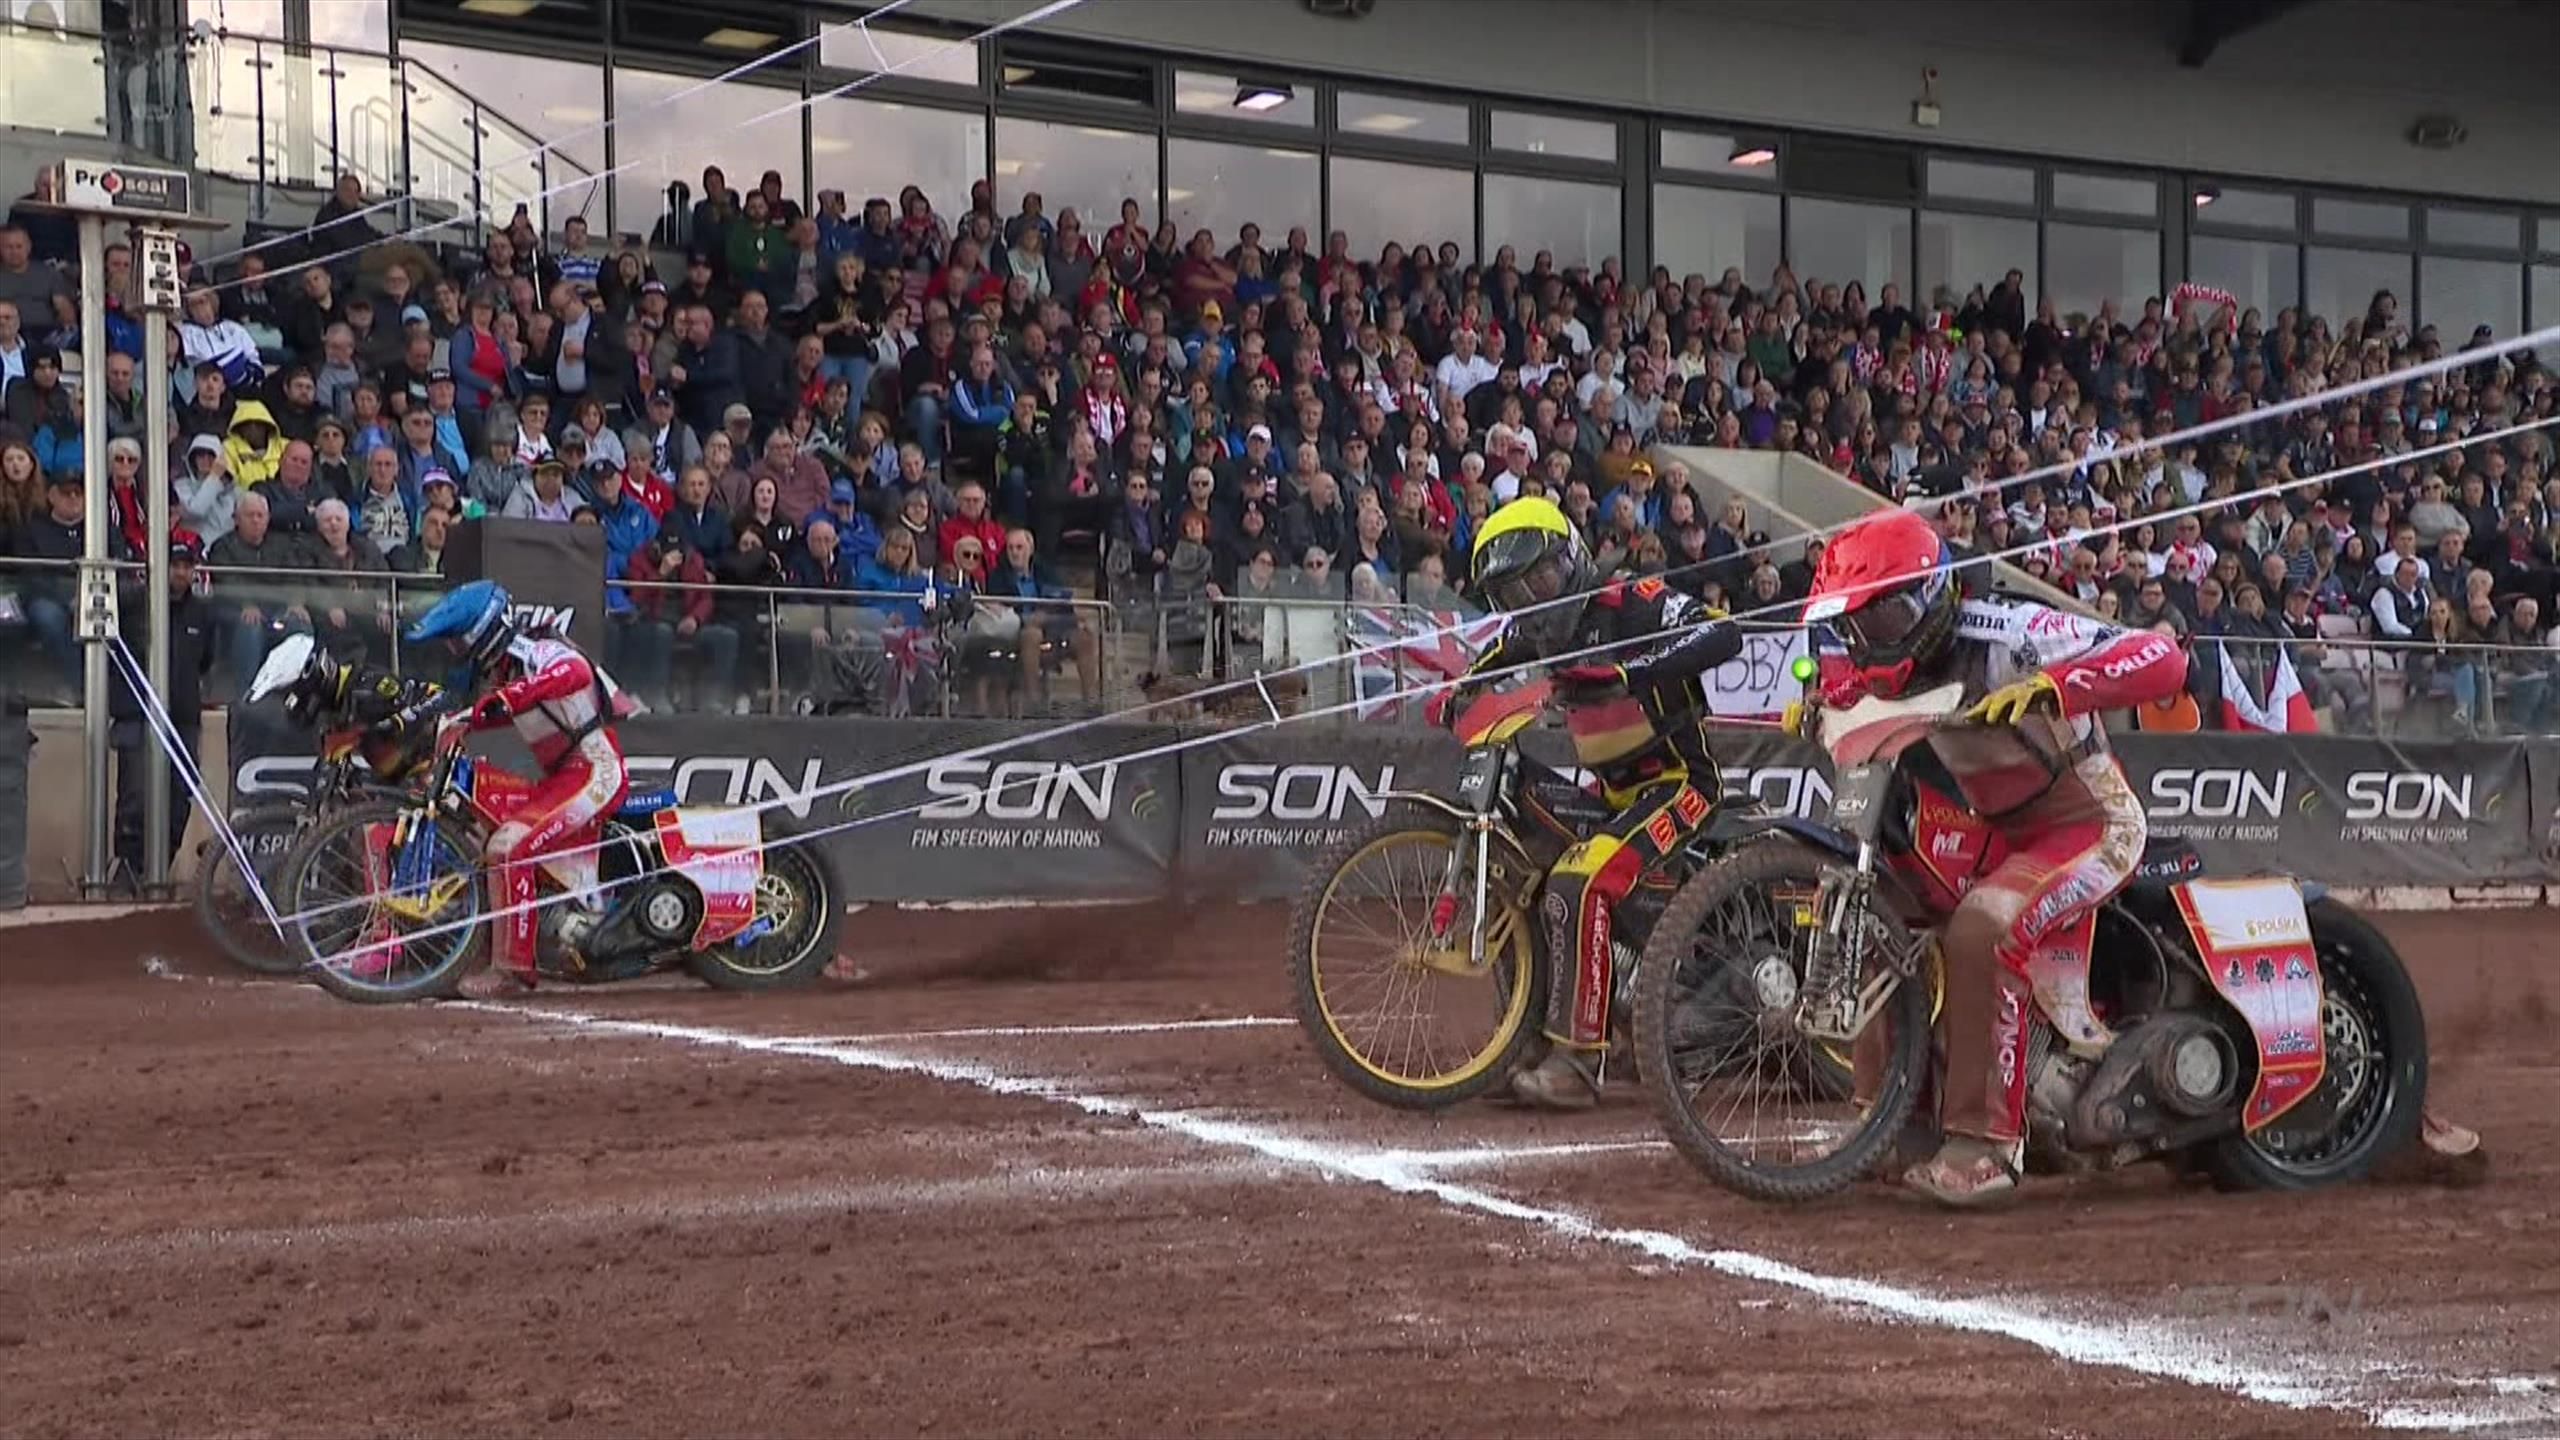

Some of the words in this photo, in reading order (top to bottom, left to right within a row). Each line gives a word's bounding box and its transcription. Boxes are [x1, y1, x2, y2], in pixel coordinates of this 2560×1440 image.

[2104, 639, 2171, 678] ORLEN
[918, 761, 1118, 820] SON
[1212, 763, 1396, 821] SON
[2147, 769, 2287, 818] SON
[2345, 771, 2473, 820] SON
[911, 829, 939, 848] FIM
[941, 828, 1021, 848] SPEEDWAY
[1022, 829, 1039, 848] OF
[1044, 829, 1102, 848] NATIONS
[1206, 828, 1230, 846] FIM
[1232, 828, 1303, 846] SPEEDWAY
[1304, 828, 1321, 846] OF
[2235, 826, 2280, 841] NATIONS
